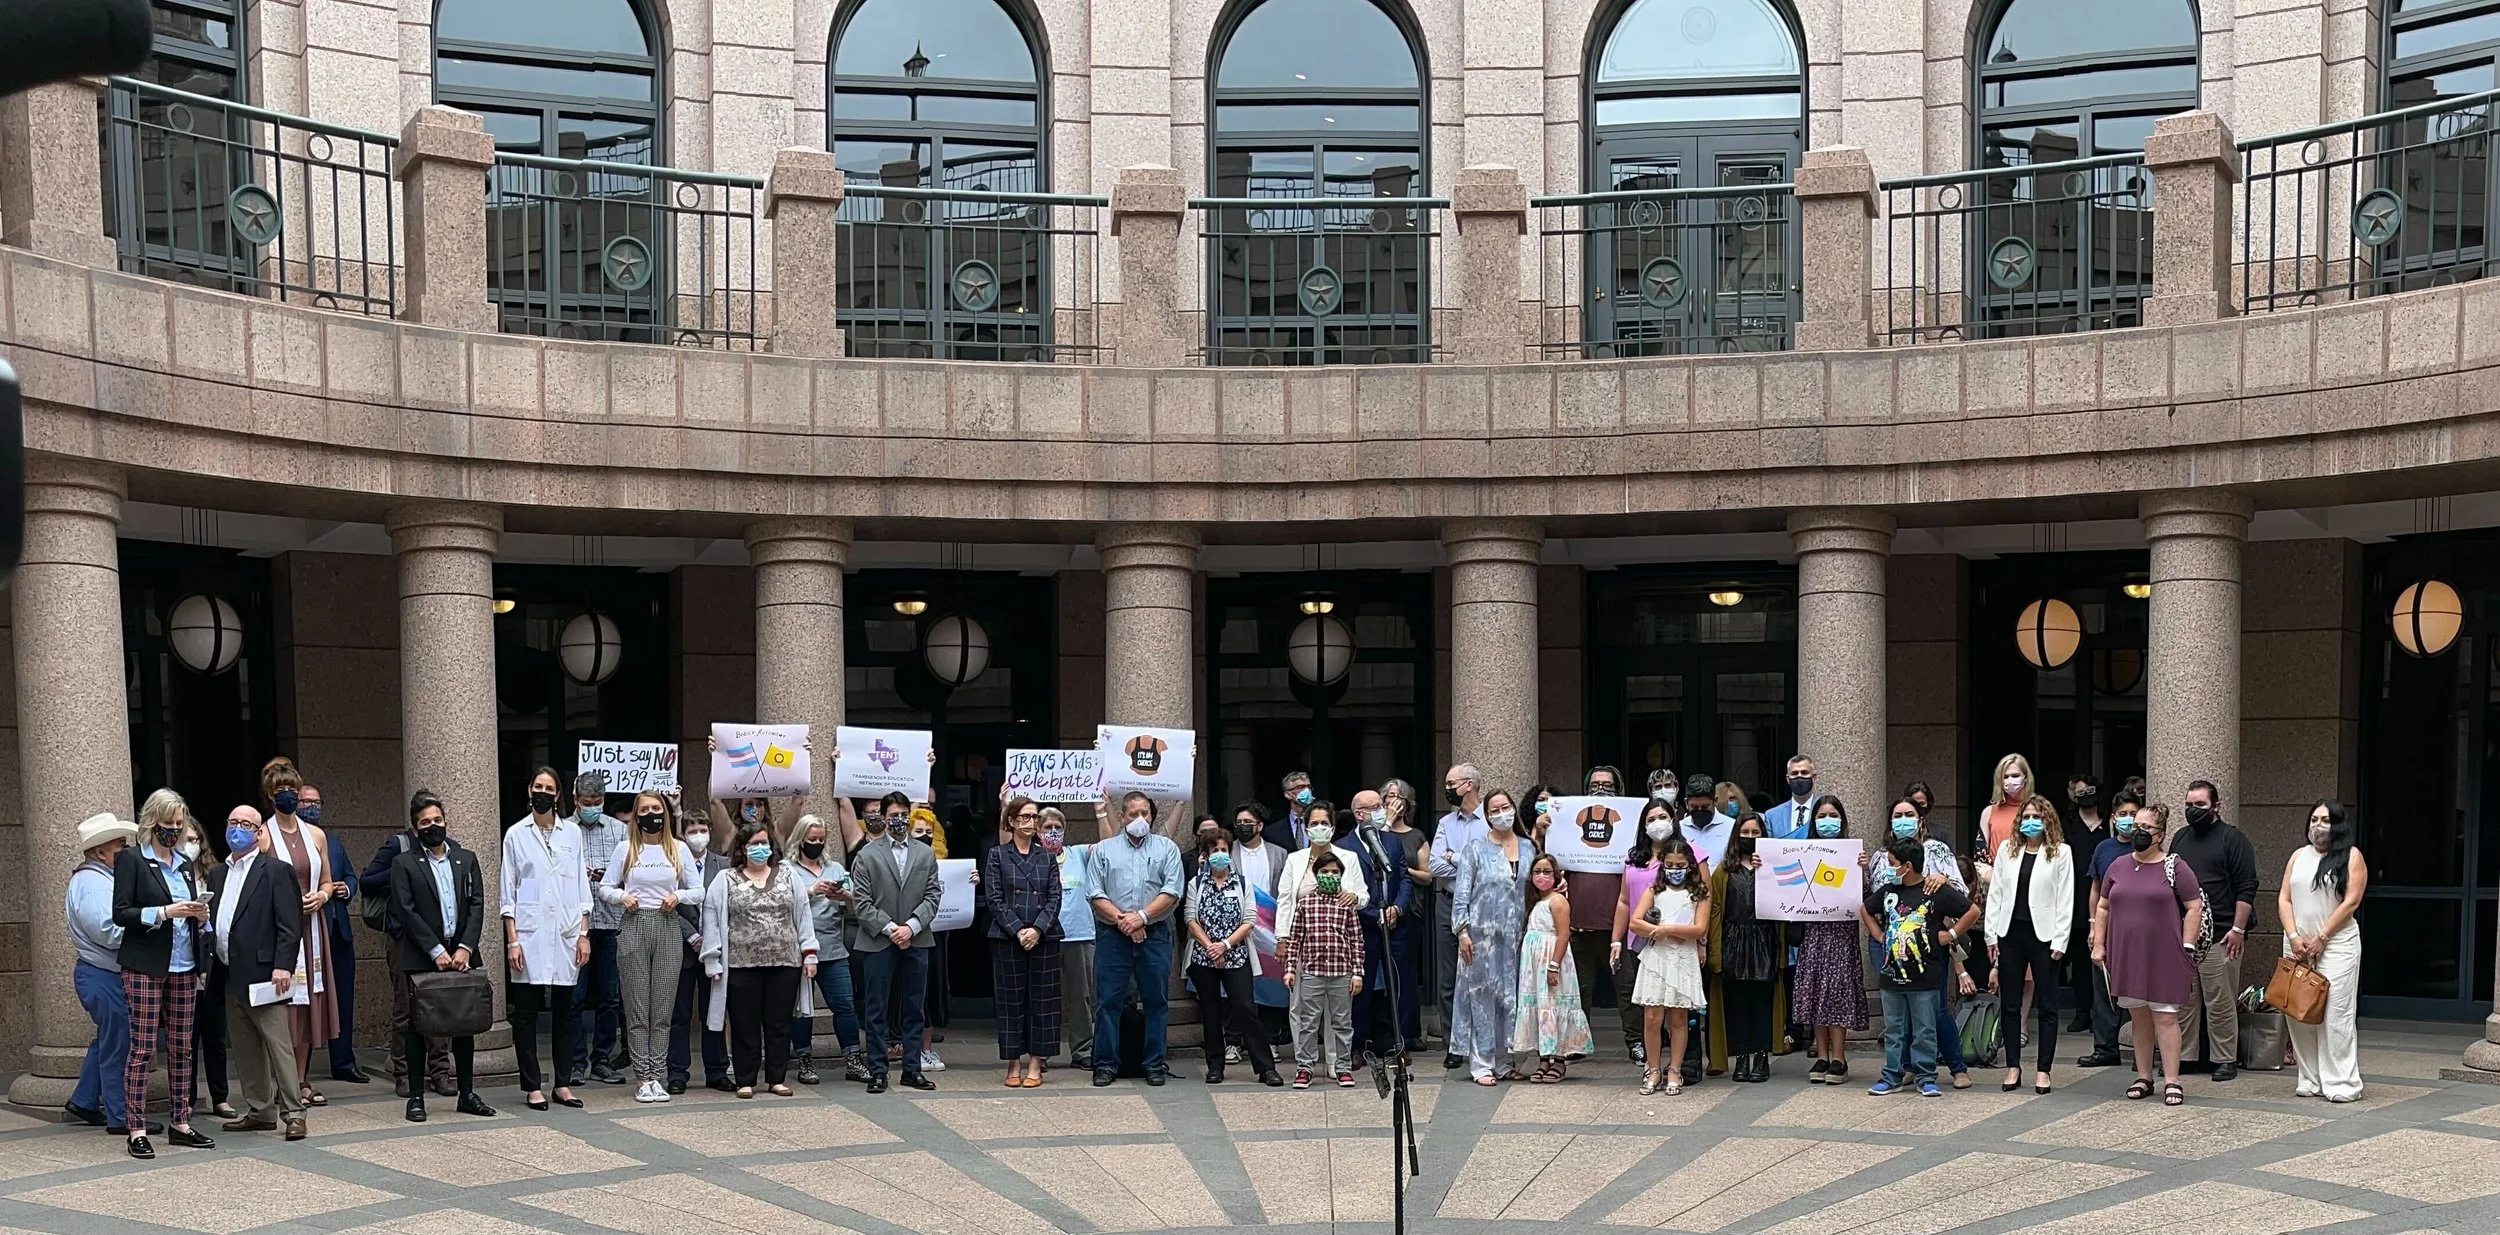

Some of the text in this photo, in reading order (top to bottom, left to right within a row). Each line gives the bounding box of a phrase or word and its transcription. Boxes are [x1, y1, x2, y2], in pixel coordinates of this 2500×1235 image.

[581, 742, 677, 771] Just say NO
[876, 751, 898, 759] TENT
[1009, 752, 1056, 773] TRANS
[616, 770, 648, 791] 1399
[1040, 790, 1088, 801] denigrate
[1804, 844, 1838, 855] AUTONOMY
[1785, 905, 1795, 913] A
[1796, 906, 1819, 915] HUMAN
[1821, 906, 1839, 915] RIGHT
